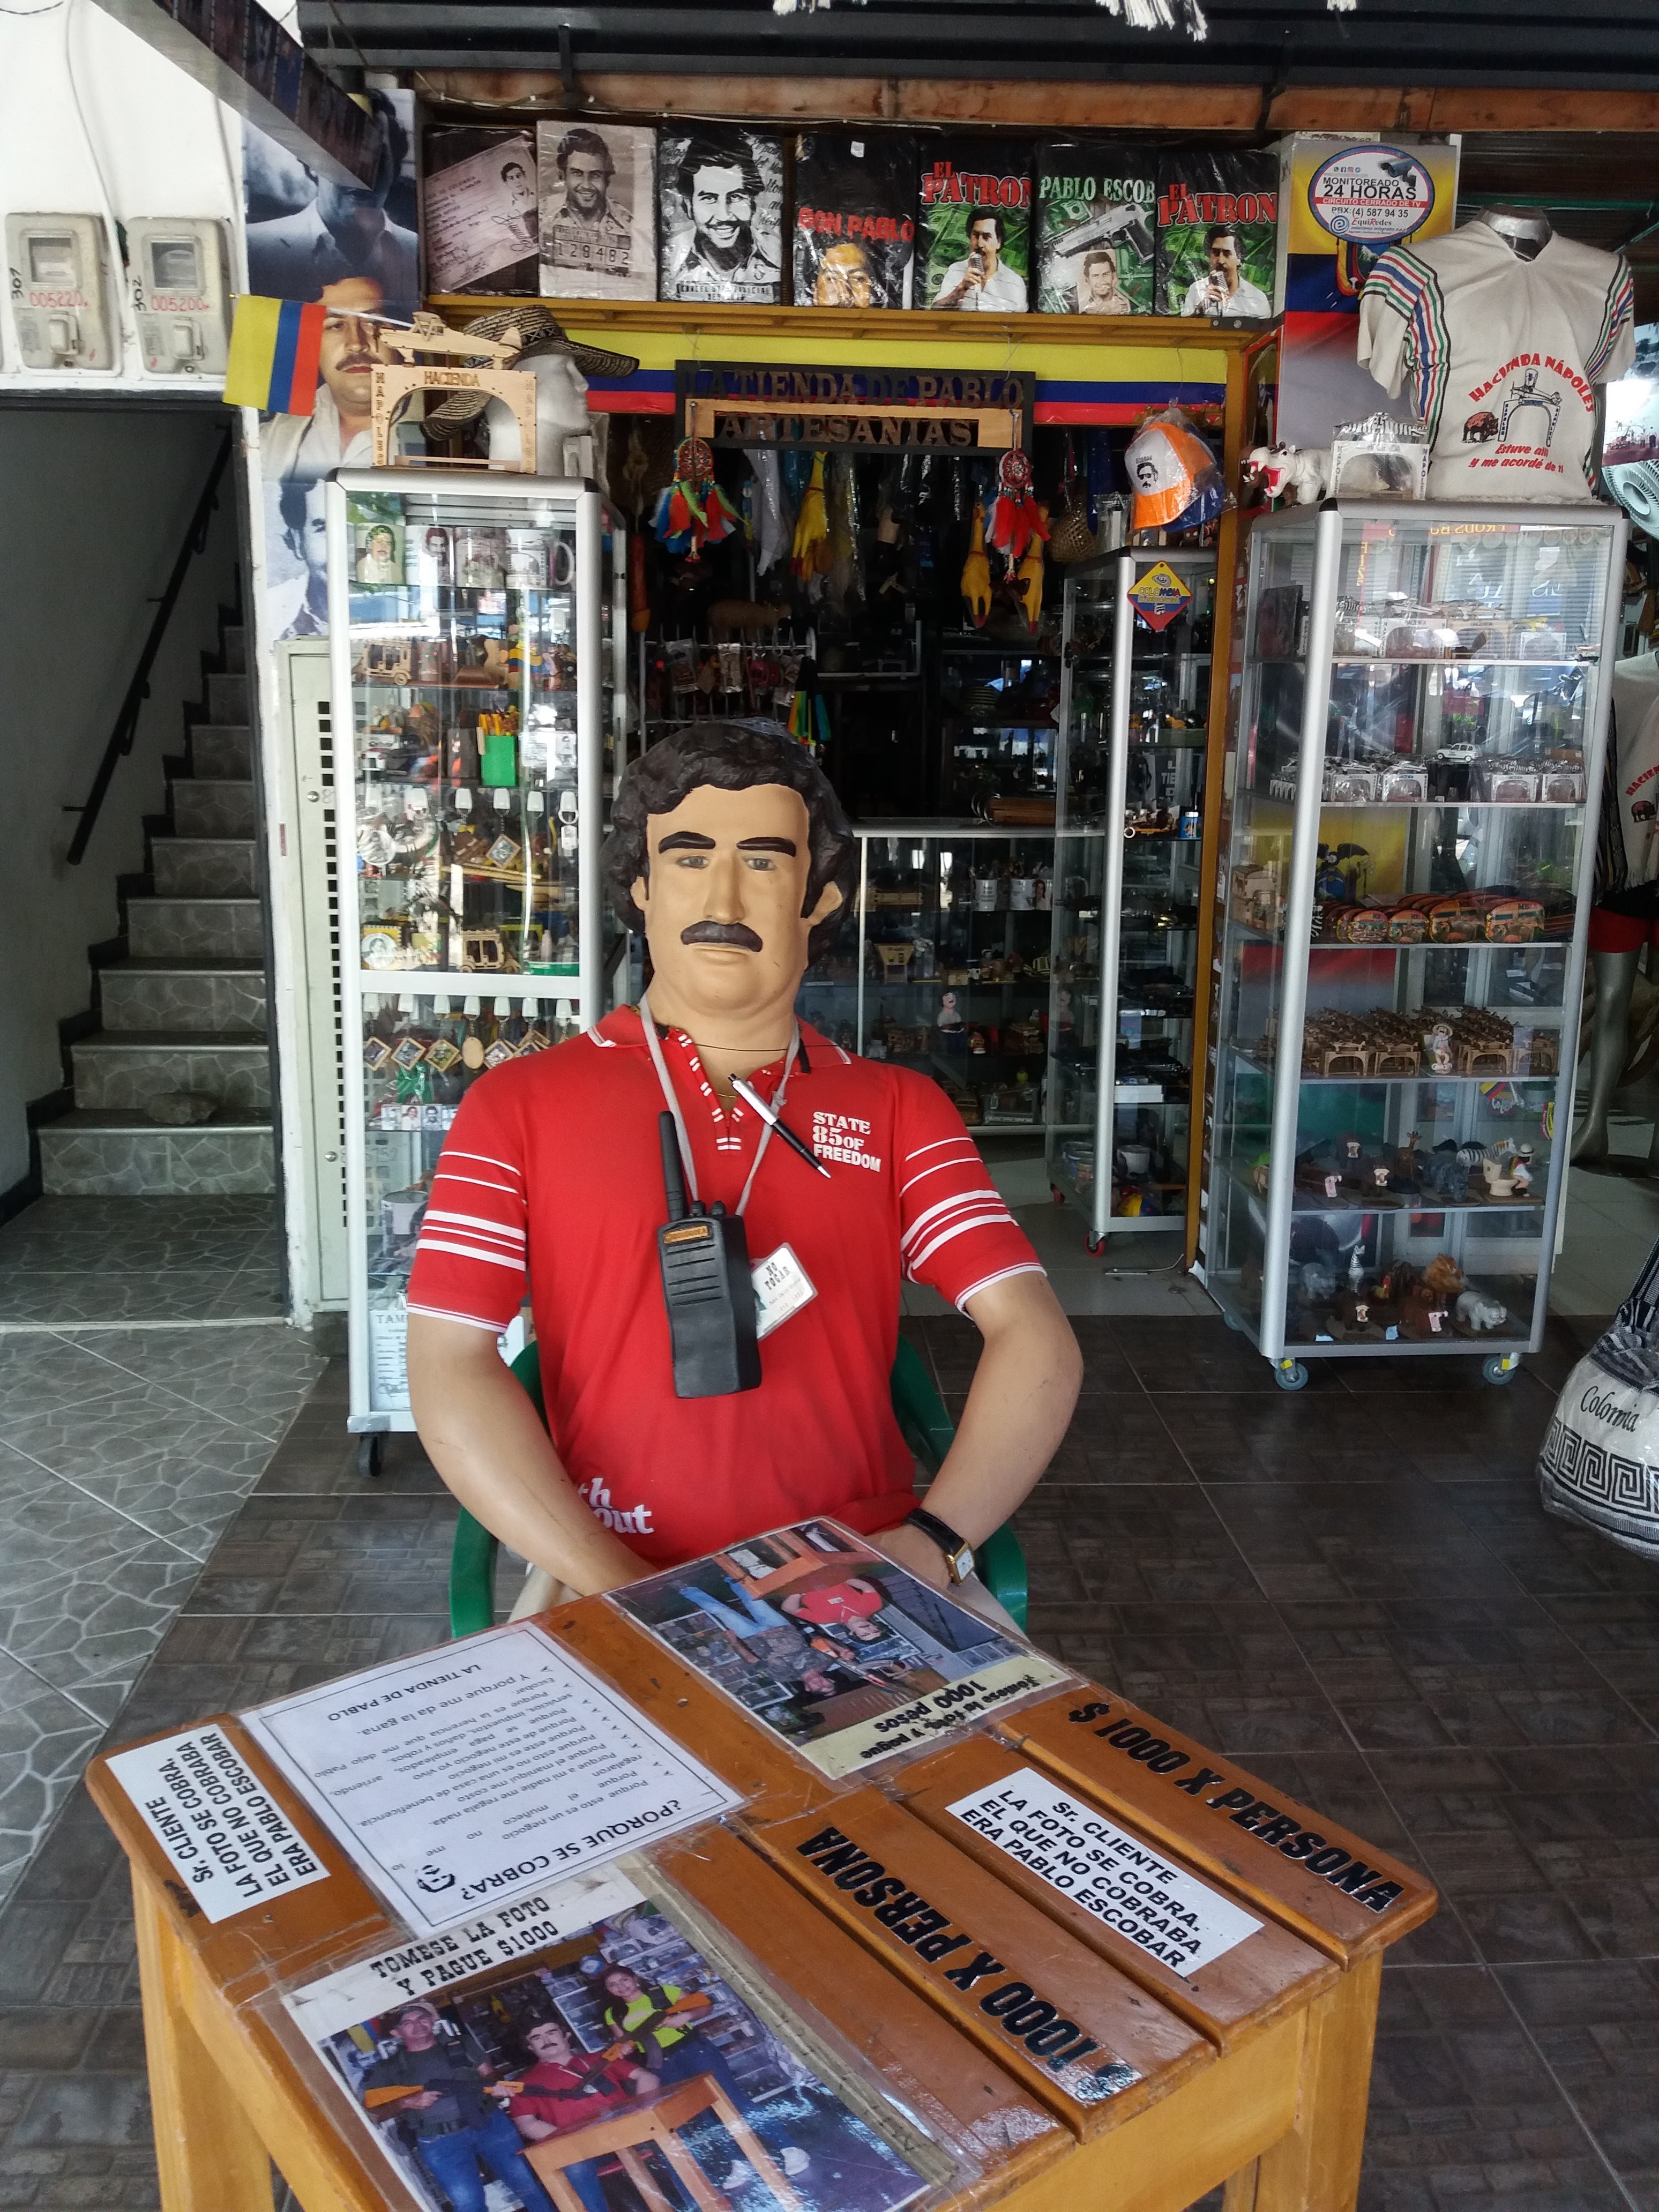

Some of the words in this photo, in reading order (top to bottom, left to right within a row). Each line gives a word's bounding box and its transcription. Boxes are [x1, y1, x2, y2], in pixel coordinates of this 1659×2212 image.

[932, 161, 954, 179] EL
[1039, 176, 1096, 201] PABLO
[1323, 177, 1399, 186] MONITOREADO
[1169, 183, 1187, 200] EL
[1324, 184, 1343, 197] 24
[1350, 185, 1416, 200] HORAS
[1157, 192, 1276, 227] PATRON
[1352, 207, 1364, 218] (4)
[1367, 208, 1382, 216] 587
[1385, 209, 1394, 218] 94
[1398, 210, 1409, 218] 35
[798, 207, 842, 237] DON
[846, 214, 914, 243] PABLO
[1351, 218, 1392, 226] EquiRedes
[132, 275, 147, 311] 302
[423, 371, 481, 387] HACIENDA
[1545, 356, 1595, 413] NÁPOLES
[734, 370, 857, 404] TIENDA
[866, 377, 910, 406] DE
[917, 376, 1023, 408] PABLO
[720, 414, 972, 446] ARTESANIAS
[1495, 444, 1531, 454] Estuve
[1468, 458, 1480, 468] y
[1481, 458, 1498, 467] me
[1500, 458, 1543, 469] acordé
[1545, 462, 1556, 472] de
[1558, 465, 1564, 473] ti
[812, 1111, 871, 1135] STATE
[812, 1126, 843, 1147] 85
[843, 1138, 865, 1150] OF
[813, 1143, 882, 1173] FREEDOM
[764, 1266, 790, 1290] TOCAR
[765, 1262, 778, 1276] NO
[459, 1664, 482, 1674] LA
[402, 1671, 462, 1693] TIENDA
[464, 1676, 517, 1699] porque
[379, 1690, 403, 1703] DE
[438, 1696, 464, 1708] me
[510, 1691, 549, 1707] Porque
[933, 1680, 986, 1708] 1000
[326, 1699, 380, 1721] PABLO
[416, 1706, 437, 1715] da
[528, 1707, 567, 1724] Porque
[874, 1701, 931, 1732] pesos
[962, 1701, 987, 1713] la
[400, 1713, 417, 1721] la
[537, 1716, 577, 1733] Porque
[428, 1717, 477, 1737] herencia
[505, 1725, 519, 1733] se
[521, 1731, 537, 1739] de
[381, 1744, 400, 1754] me
[403, 1735, 425, 1746] que
[468, 1733, 496, 1746] paga
[498, 1737, 522, 1748] este
[556, 1733, 597, 1751] Porque
[860, 1733, 911, 1758] pague
[200, 1733, 257, 1794] ESCOBAR
[350, 1753, 377, 1765] dejo
[453, 1746, 497, 1765] negocio
[515, 1758, 532, 1767] no
[531, 1749, 556, 1760] esto
[176, 1742, 231, 1804] COBRABA
[313, 1763, 348, 1777] Pablo
[412, 1768, 437, 1780] vivo
[437, 1761, 453, 1770] yo
[500, 1765, 515, 1773] es
[591, 1754, 642, 1777] regalaron
[159, 1758, 201, 1809] COBRA.
[451, 1778, 477, 1791] casa
[477, 1770, 500, 1781] una
[597, 1770, 638, 1788] Porque
[435, 1789, 451, 1797] de
[566, 1792, 579, 1801] el
[607, 1779, 649, 1797] Porque
[564, 1806, 579, 1815] es
[579, 1796, 605, 1809] esto
[1068, 1702, 1110, 1724] $
[1094, 1718, 1190, 1775] 1000
[1174, 1767, 1226, 1796] X
[1206, 1788, 1404, 1914] PERSONA
[190, 1809, 217, 1830] SE
[222, 1807, 250, 1829] NO
[246, 1796, 293, 1842] PABLO
[502, 1804, 549, 1825] muñeco
[547, 1812, 565, 1821] un
[580, 1799, 682, 1848] ¿PORQUE
[145, 1797, 198, 1859] CLIENTE
[466, 1830, 483, 1840] no
[501, 1818, 547, 1840] negocio
[206, 1832, 246, 1873] FOTO
[237, 1829, 273, 1863] QUE
[424, 1845, 446, 1856] me
[550, 1842, 582, 1860] SE
[1052, 1802, 1078, 1821] Sr.
[1083, 1822, 1177, 1884] CLIENTE
[282, 1842, 317, 1875] ERA
[998, 1790, 1027, 1811] LA
[1027, 1810, 1085, 1848] FOTO
[1086, 1849, 1119, 1871] SE
[1119, 1872, 1199, 1931] COBRA.
[192, 1859, 213, 1882] Sr.
[264, 1863, 290, 1886] EL
[460, 1855, 550, 1900] COBRA?
[979, 1799, 1006, 1820] EL
[1009, 1820, 1057, 1851] QUE
[1053, 1851, 1090, 1874] NO
[1092, 1877, 1200, 1953] COBRABA
[235, 1873, 263, 1897] LA
[795, 1825, 973, 1964] PERSONA
[960, 1809, 1004, 1840] ERA
[1003, 1839, 1074, 1887] PABLO
[1074, 1889, 1185, 1966] ESCOBAR
[371, 1935, 460, 1979] TOMESE
[466, 1920, 498, 1943] LA
[497, 1896, 550, 1931] FOTO
[396, 1978, 416, 1997] Y
[422, 1948, 493, 1989] PAGUE
[499, 1919, 559, 1958] $1000
[943, 1951, 1006, 1992] X
[978, 1982, 1100, 2073] 1000
